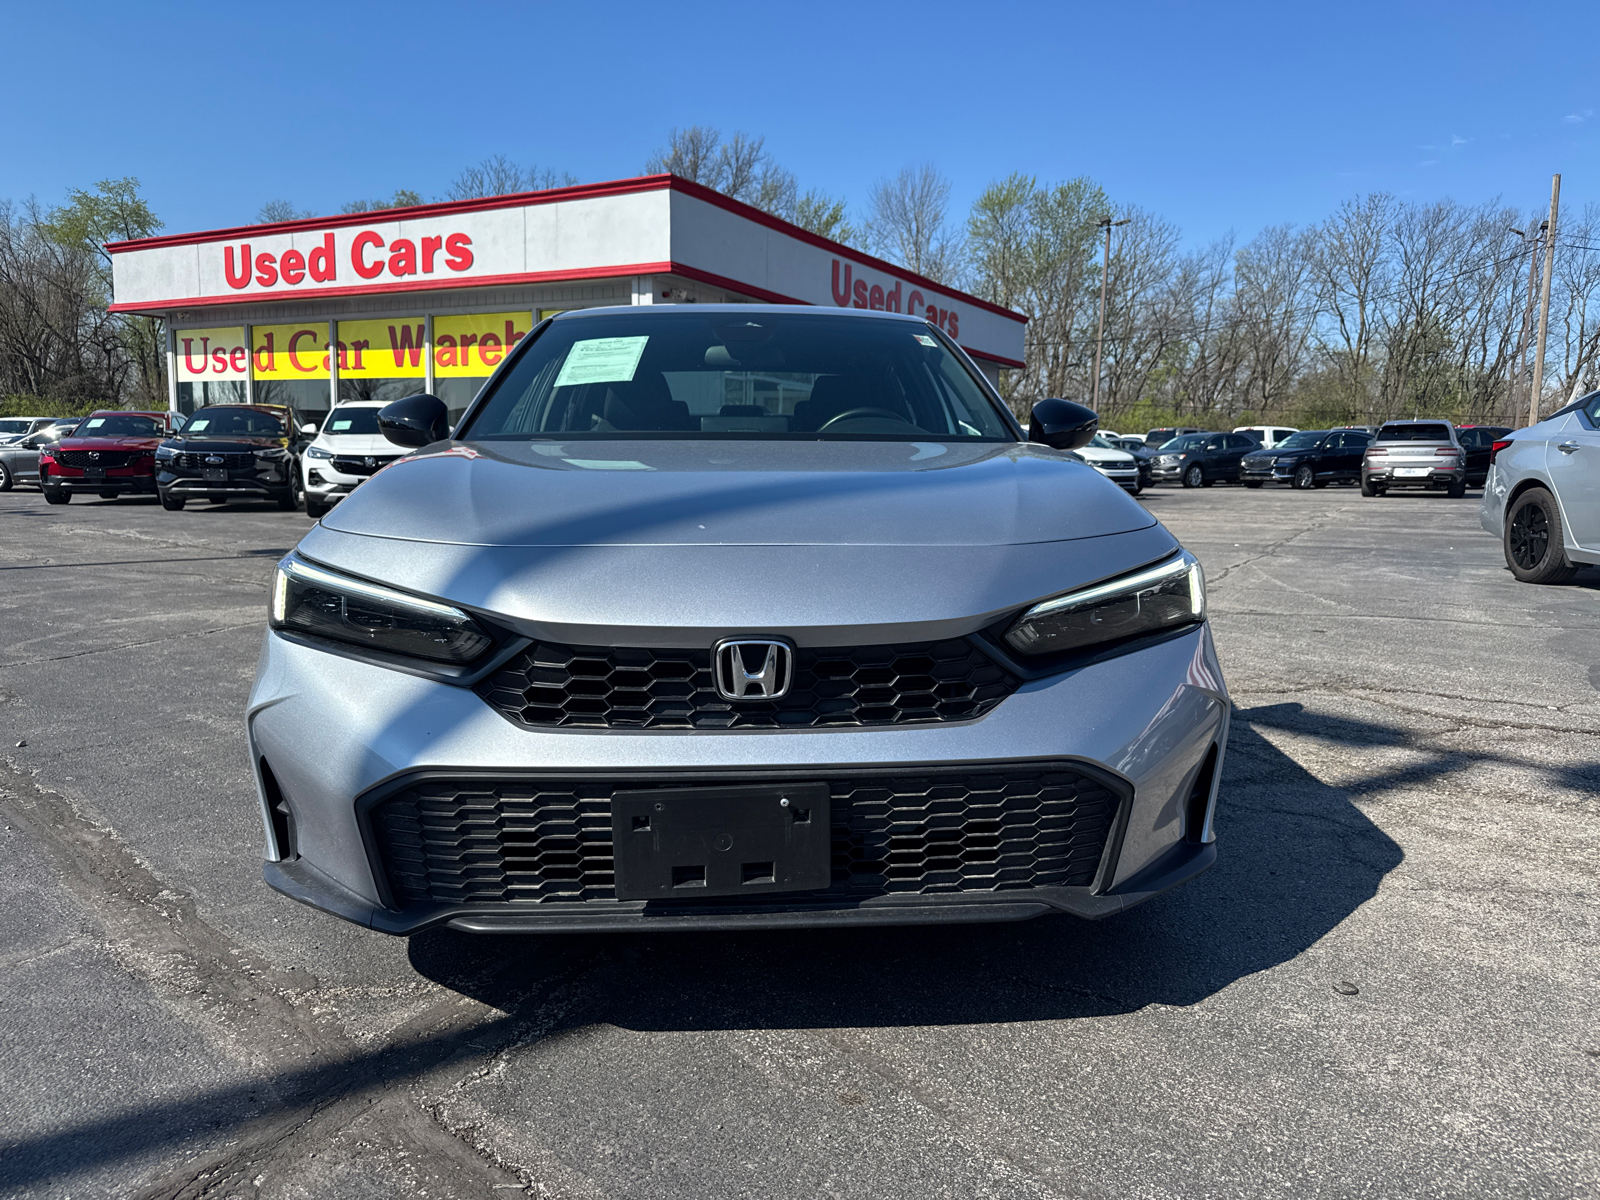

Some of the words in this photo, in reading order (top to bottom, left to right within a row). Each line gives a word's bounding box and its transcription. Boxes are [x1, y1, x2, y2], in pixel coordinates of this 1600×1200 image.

[224, 232, 337, 290] Used
[351, 230, 474, 280] Cars
[831, 258, 902, 313] Used
[181, 332, 277, 375] Used
[288, 329, 371, 373] Car
